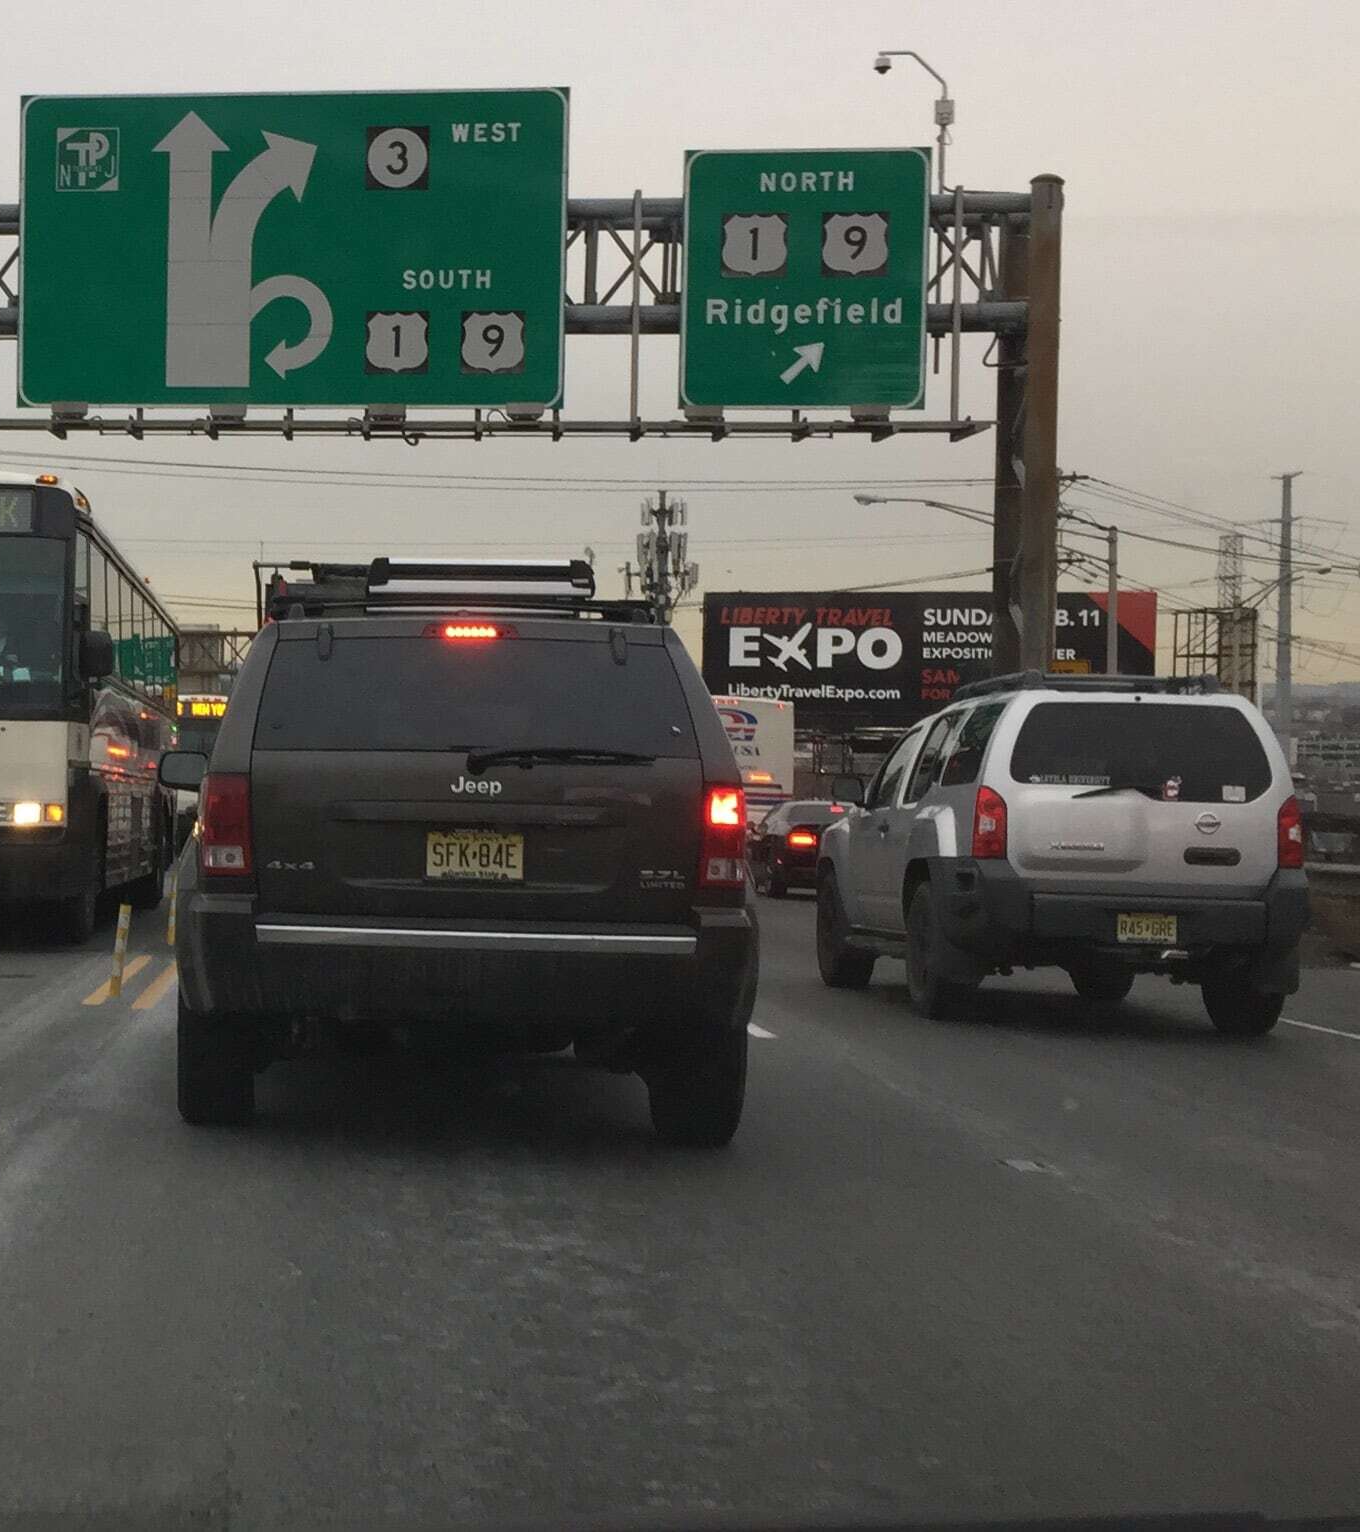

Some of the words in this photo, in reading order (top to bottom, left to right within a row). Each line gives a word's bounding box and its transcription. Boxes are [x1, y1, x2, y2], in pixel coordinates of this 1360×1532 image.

[451, 122, 522, 143] WEST
[387, 140, 409, 176] 3
[760, 171, 854, 192] NORTH
[749, 227, 759, 261] 1
[844, 226, 868, 260] 9
[402, 269, 492, 290] SOUTH
[706, 297, 902, 335] Ridgefield
[392, 325, 402, 358] 1
[483, 324, 504, 359] 9
[720, 607, 807, 625] LIBERTY
[816, 609, 893, 626] TRAVEL
[1078, 609, 1100, 627] 11
[728, 622, 903, 672] EXPO
[728, 683, 900, 701] LibertyTravelExpo.com
[450, 775, 502, 797] Jeep
